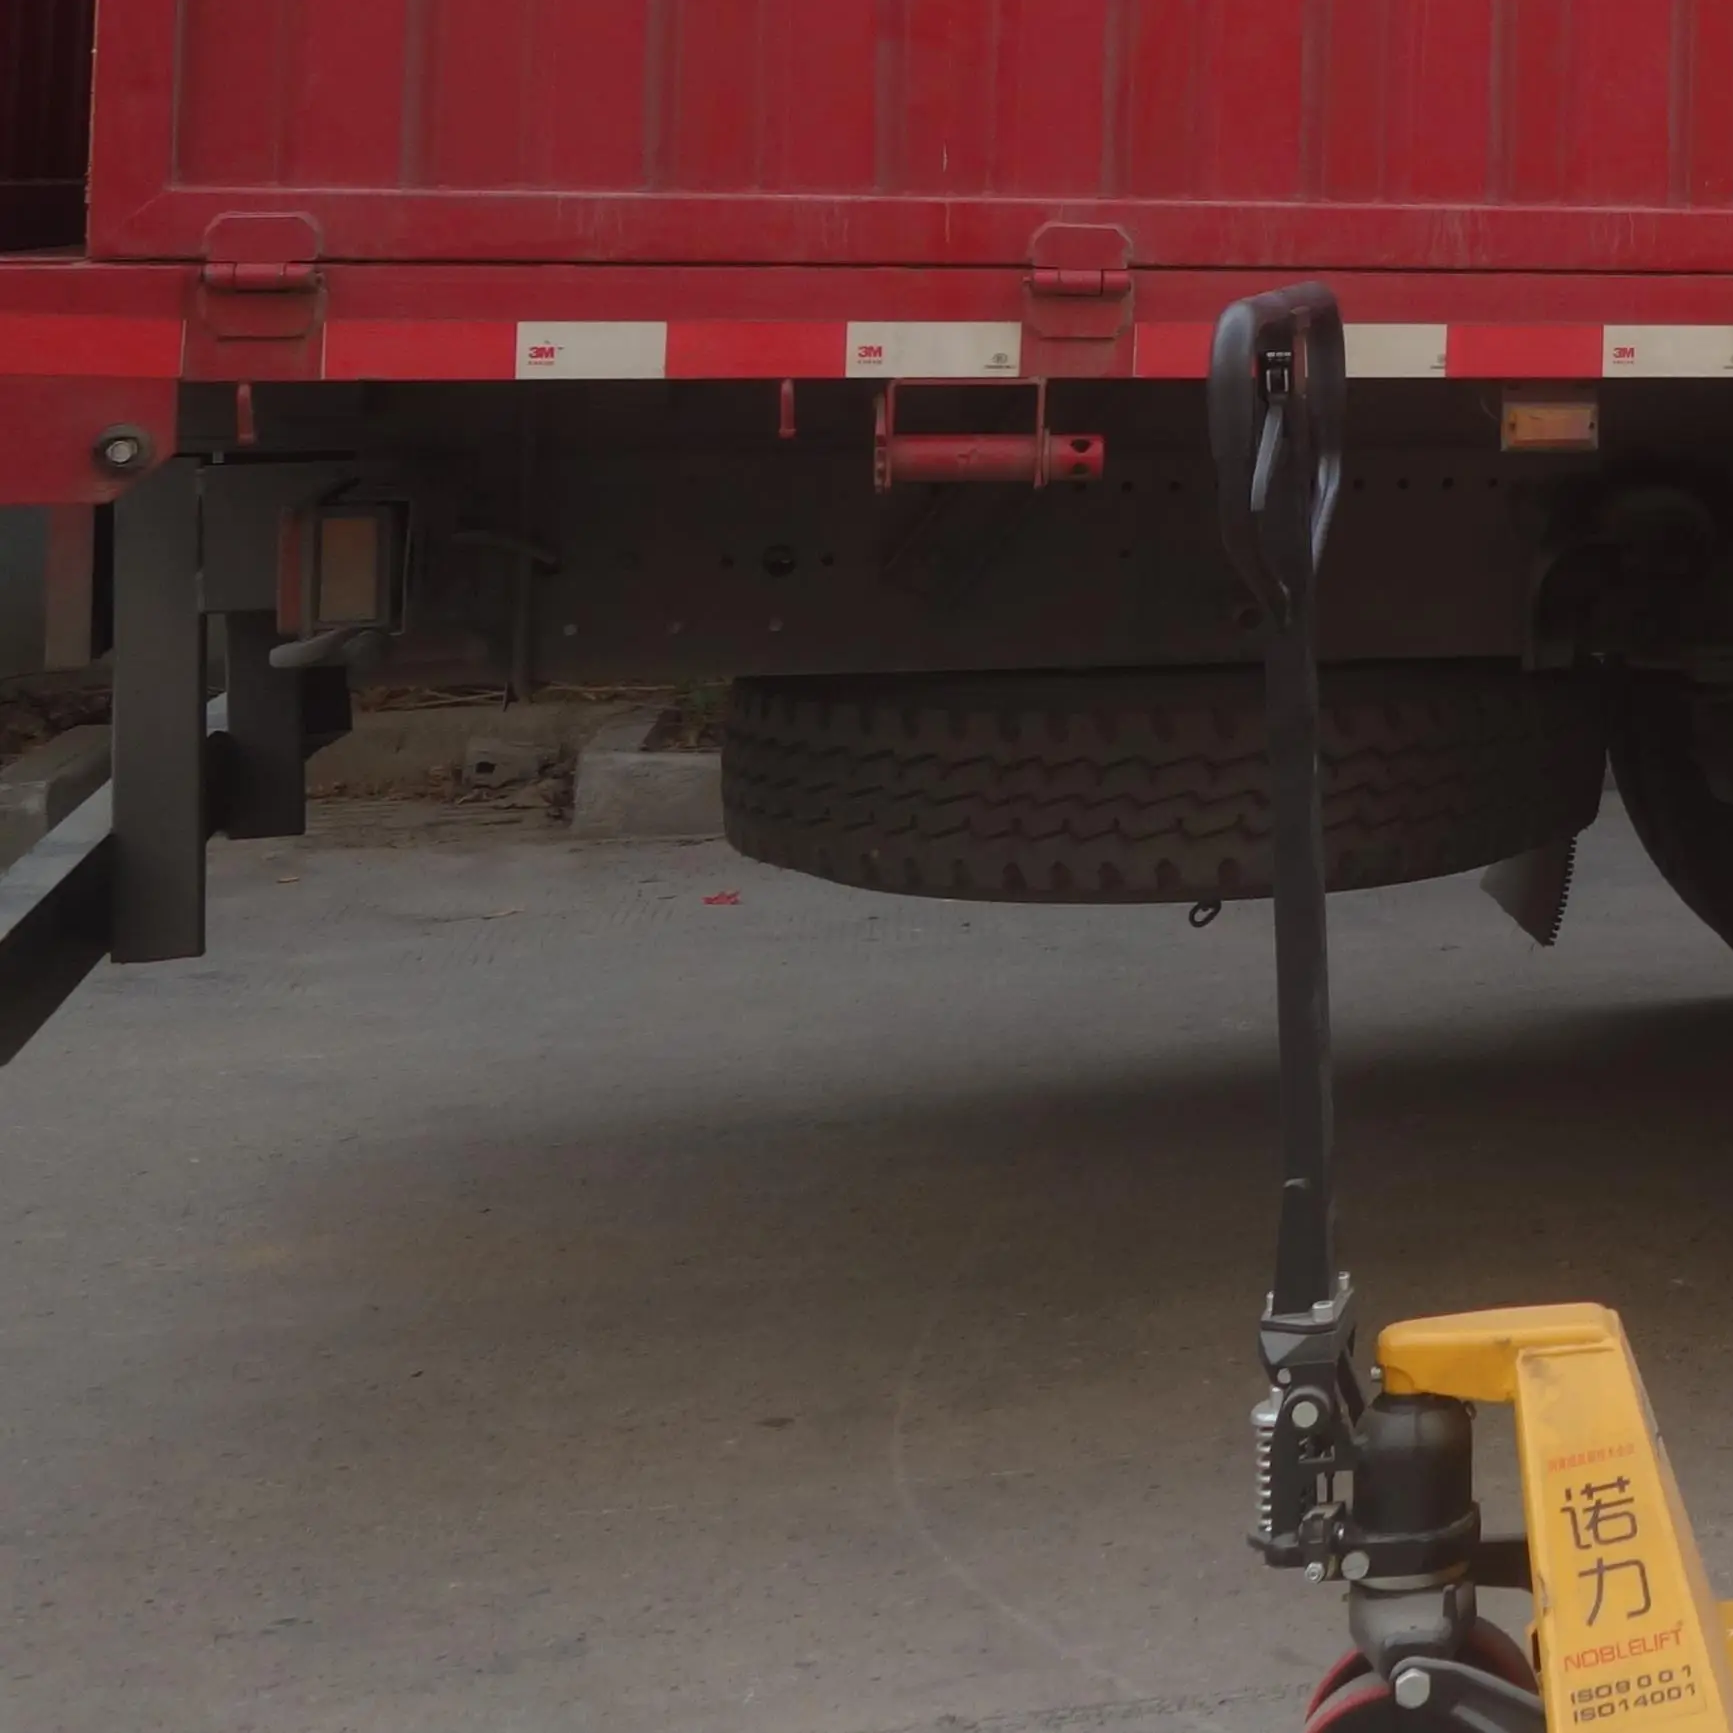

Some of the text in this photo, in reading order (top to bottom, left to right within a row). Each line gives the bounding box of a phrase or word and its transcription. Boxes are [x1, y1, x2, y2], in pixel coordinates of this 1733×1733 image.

[528, 346, 555, 359] 3M
[858, 345, 883, 358] 3M
[1613, 347, 1635, 359] 3M
[1559, 1476, 1653, 1628] 诺力
[1563, 1627, 1683, 1672] NOBLELIFT
[1573, 1682, 1698, 1725] ISO14001
